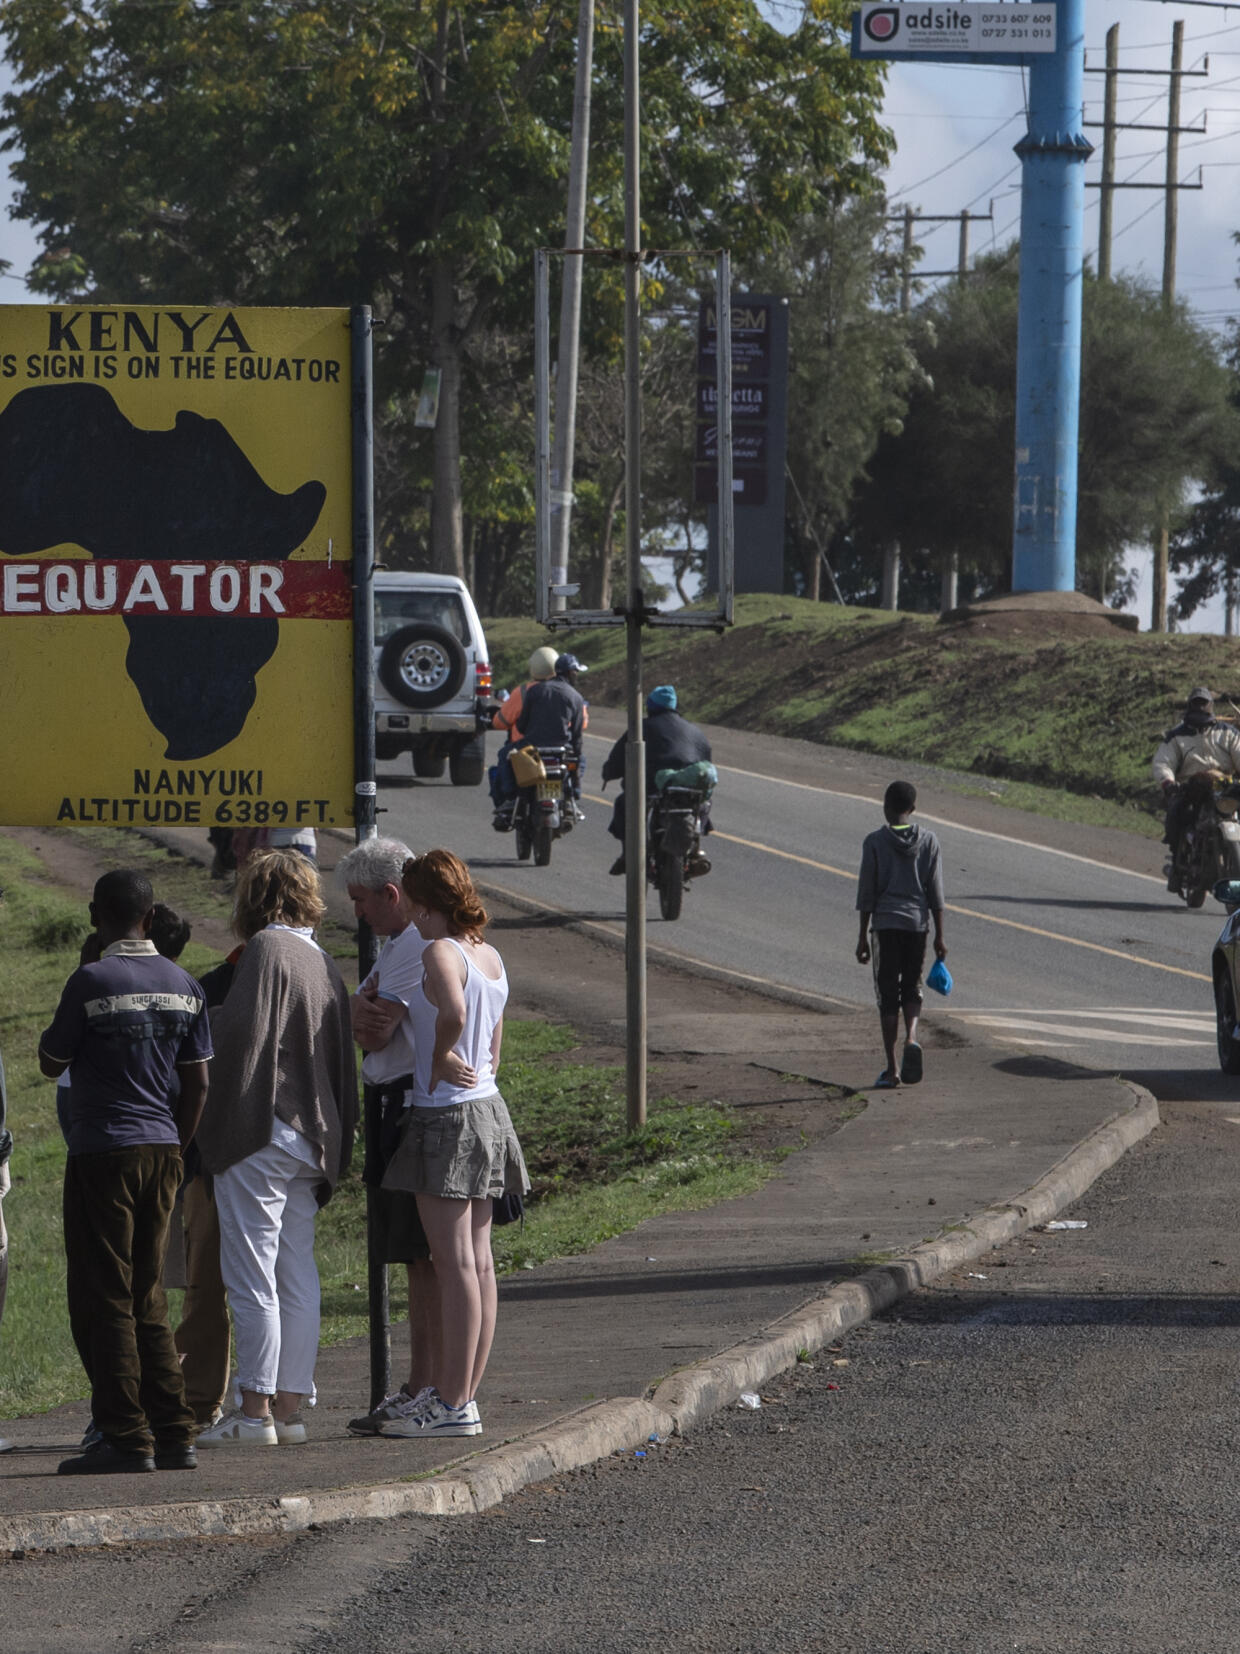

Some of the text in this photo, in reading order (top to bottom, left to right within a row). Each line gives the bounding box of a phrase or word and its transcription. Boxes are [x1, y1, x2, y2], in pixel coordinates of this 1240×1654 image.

[905, 7, 972, 29] adsite
[982, 14, 1052, 24] 0733 607 609
[982, 28, 1052, 38] 0727 531 013
[46, 311, 257, 353] KENYA
[26, 354, 85, 380] SIGN
[94, 354, 118, 380] IS
[128, 355, 160, 380] ON
[170, 355, 215, 380] THE
[224, 356, 340, 383] EQUATOR
[3, 564, 286, 615] EQUATOR
[134, 768, 264, 796] NANYUKI
[57, 797, 336, 824] ALTITUDE 6389 FT.
